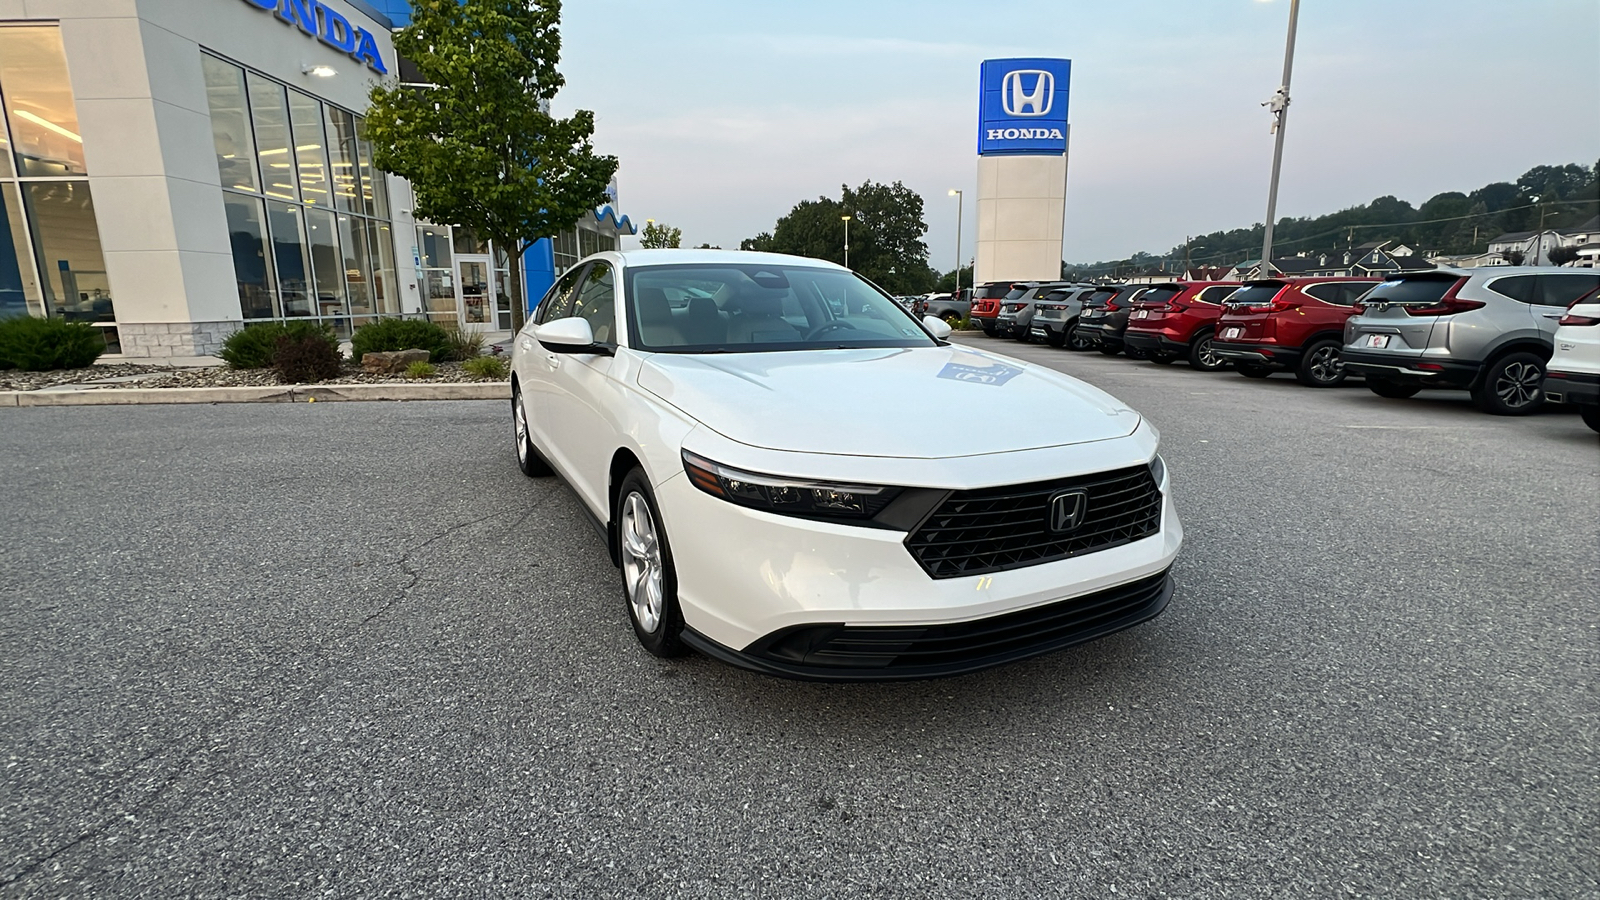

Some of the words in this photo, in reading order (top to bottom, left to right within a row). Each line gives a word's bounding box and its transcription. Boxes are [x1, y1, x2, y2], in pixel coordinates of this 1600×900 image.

[243, 0, 388, 74] NDA
[1011, 70, 1046, 116] H
[986, 128, 1065, 140] HONDA
